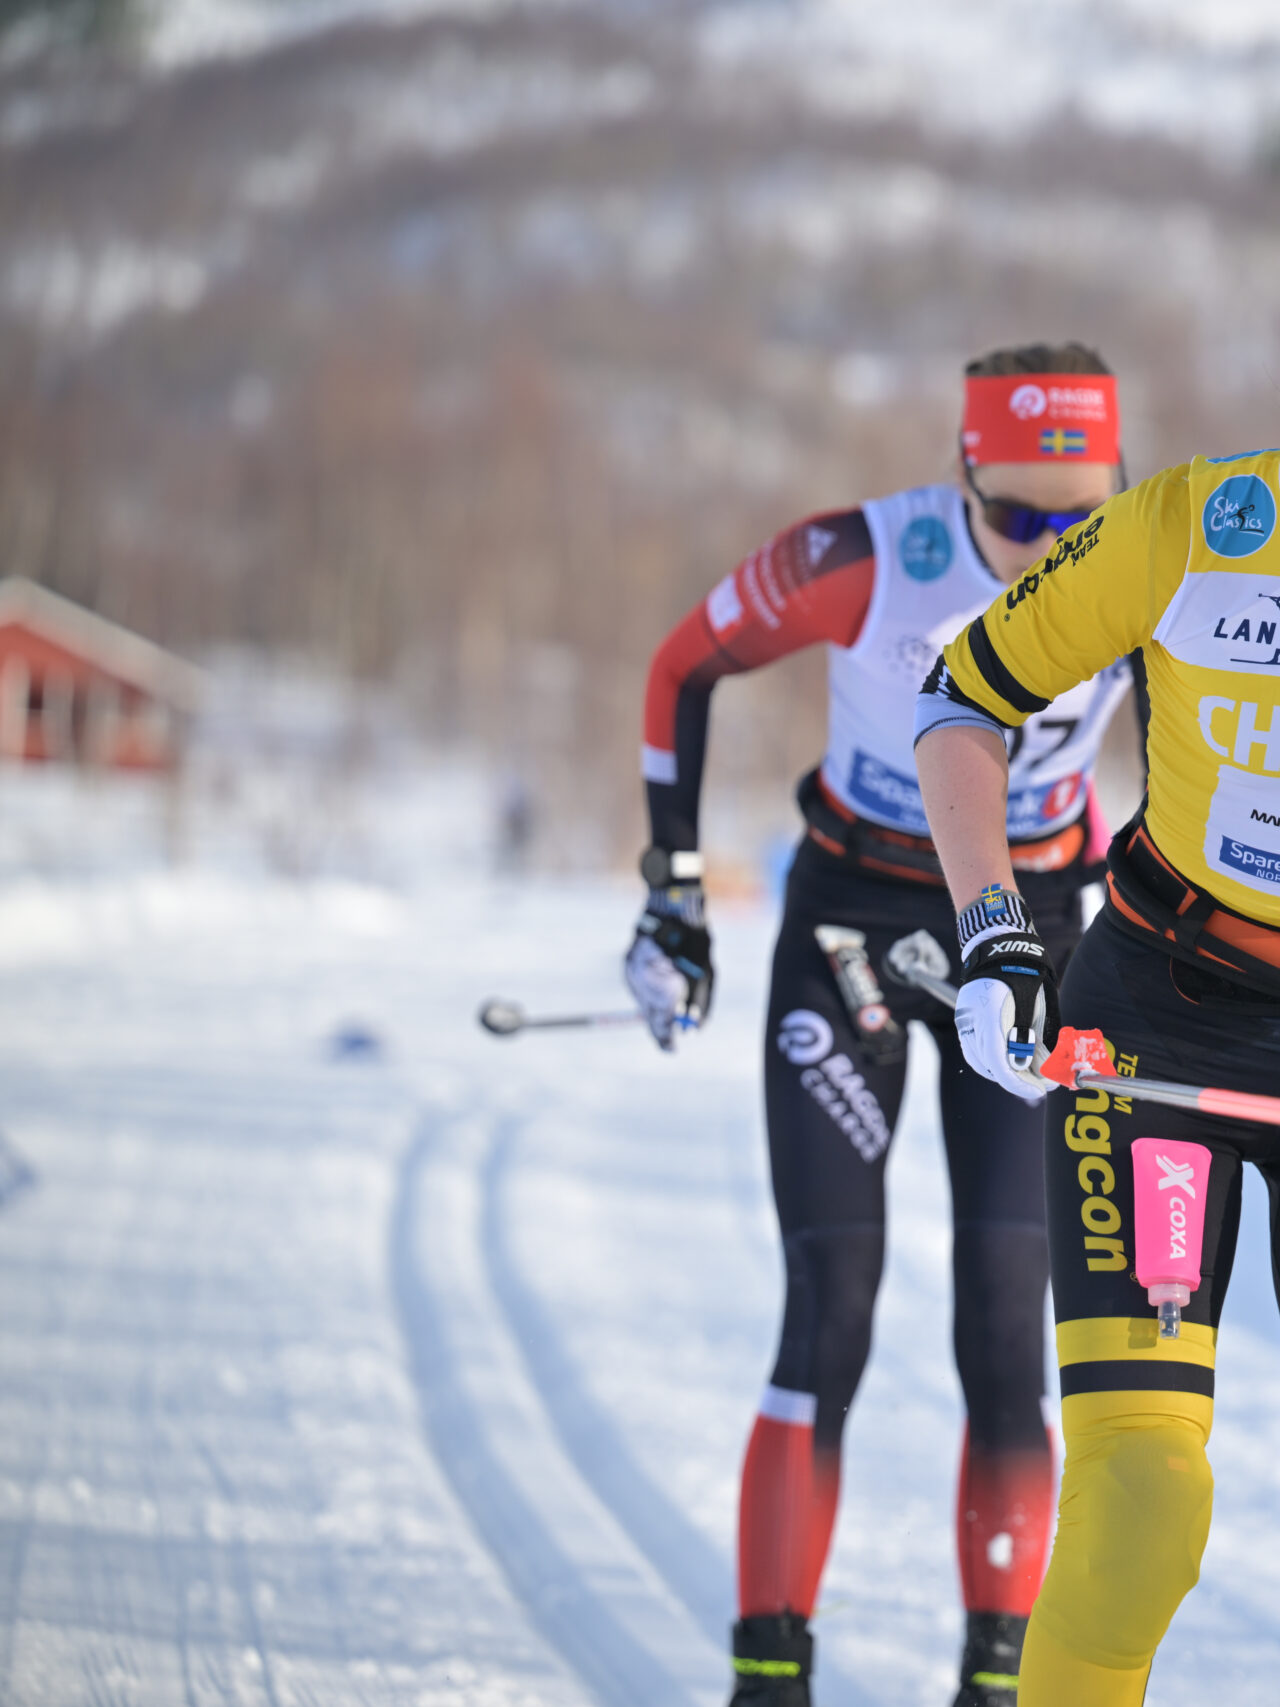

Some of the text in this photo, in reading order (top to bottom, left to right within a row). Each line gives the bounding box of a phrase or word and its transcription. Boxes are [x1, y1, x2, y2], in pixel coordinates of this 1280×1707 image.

[1213, 496, 1240, 518] Ski
[1113, 1052, 1138, 1115] TEM
[1064, 1037, 1129, 1272] ngcon
[1169, 1196, 1187, 1260] COXA
